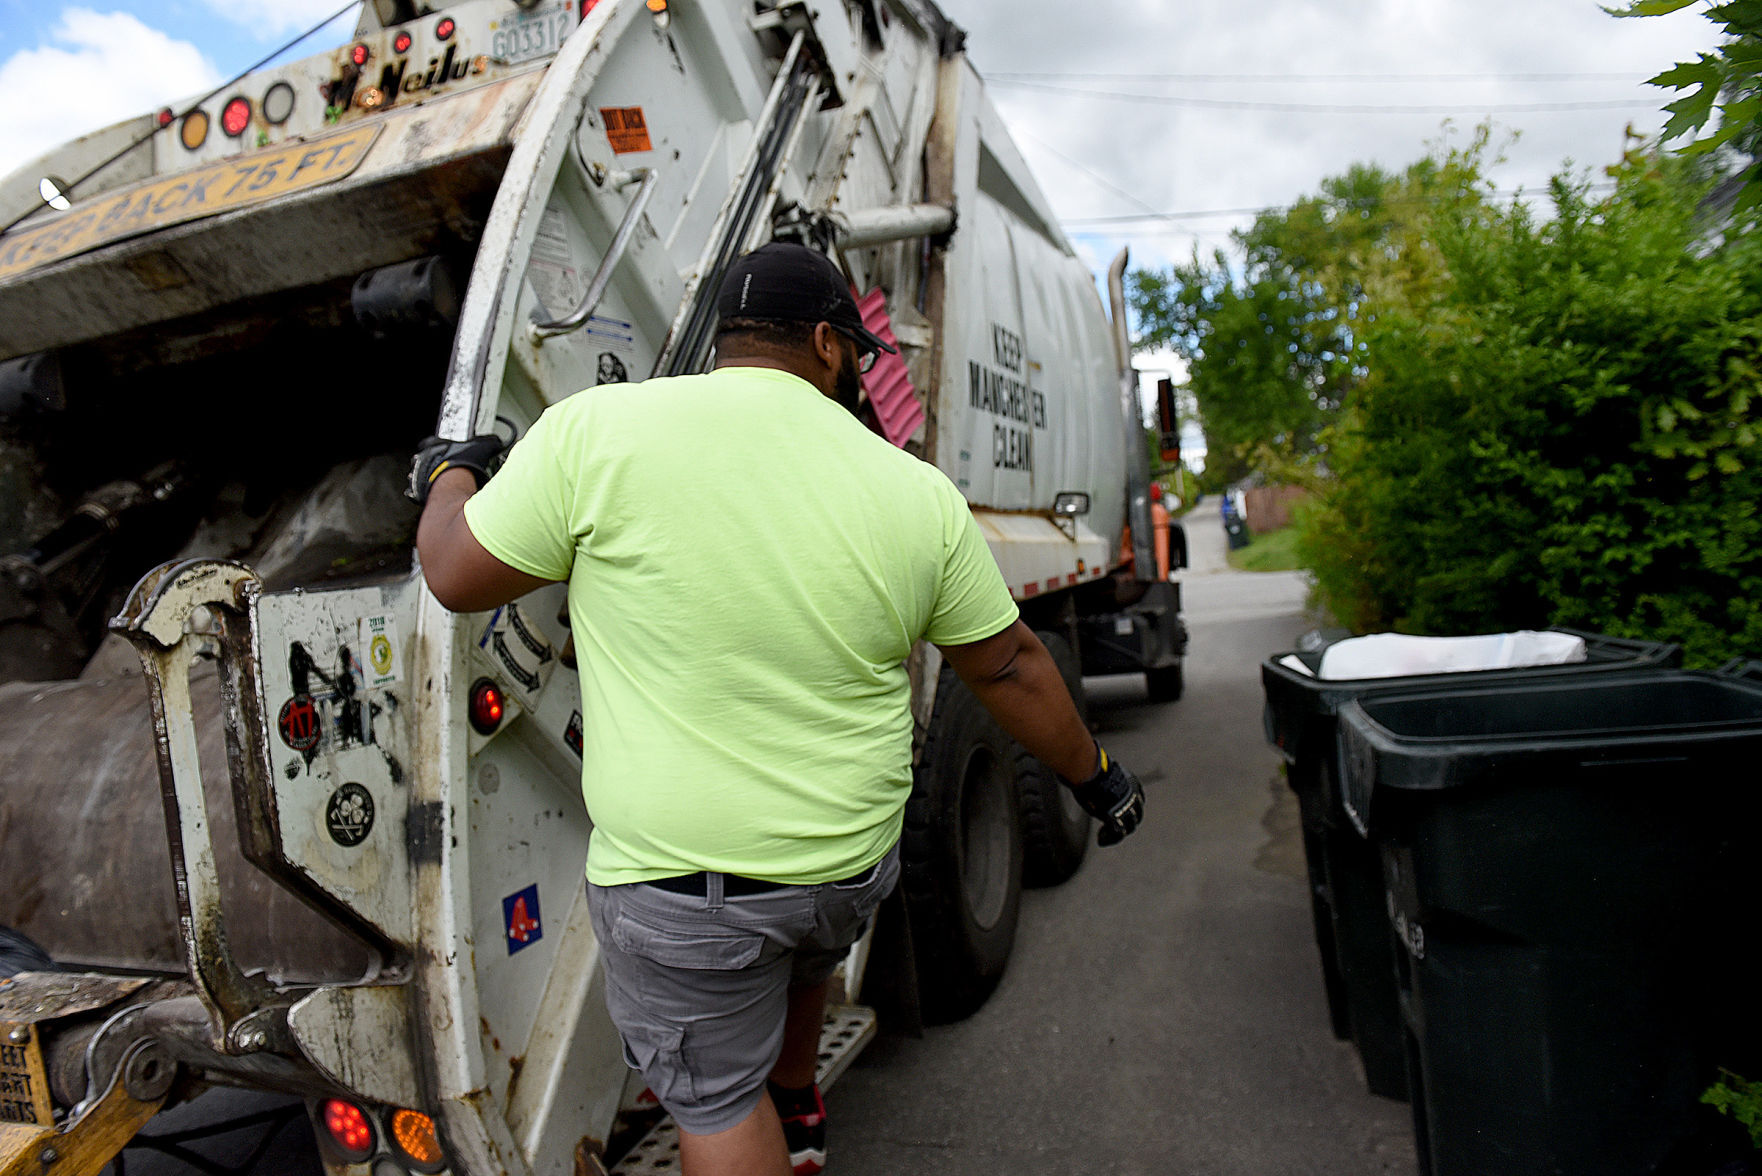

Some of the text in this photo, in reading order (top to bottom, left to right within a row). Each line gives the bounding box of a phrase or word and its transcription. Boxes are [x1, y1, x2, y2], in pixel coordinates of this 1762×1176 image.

[97, 173, 222, 232] BACK
[225, 158, 286, 198] 75
[287, 140, 355, 181] FT.
[992, 322, 1022, 375] KEEP
[993, 424, 1033, 471] CLEAN
